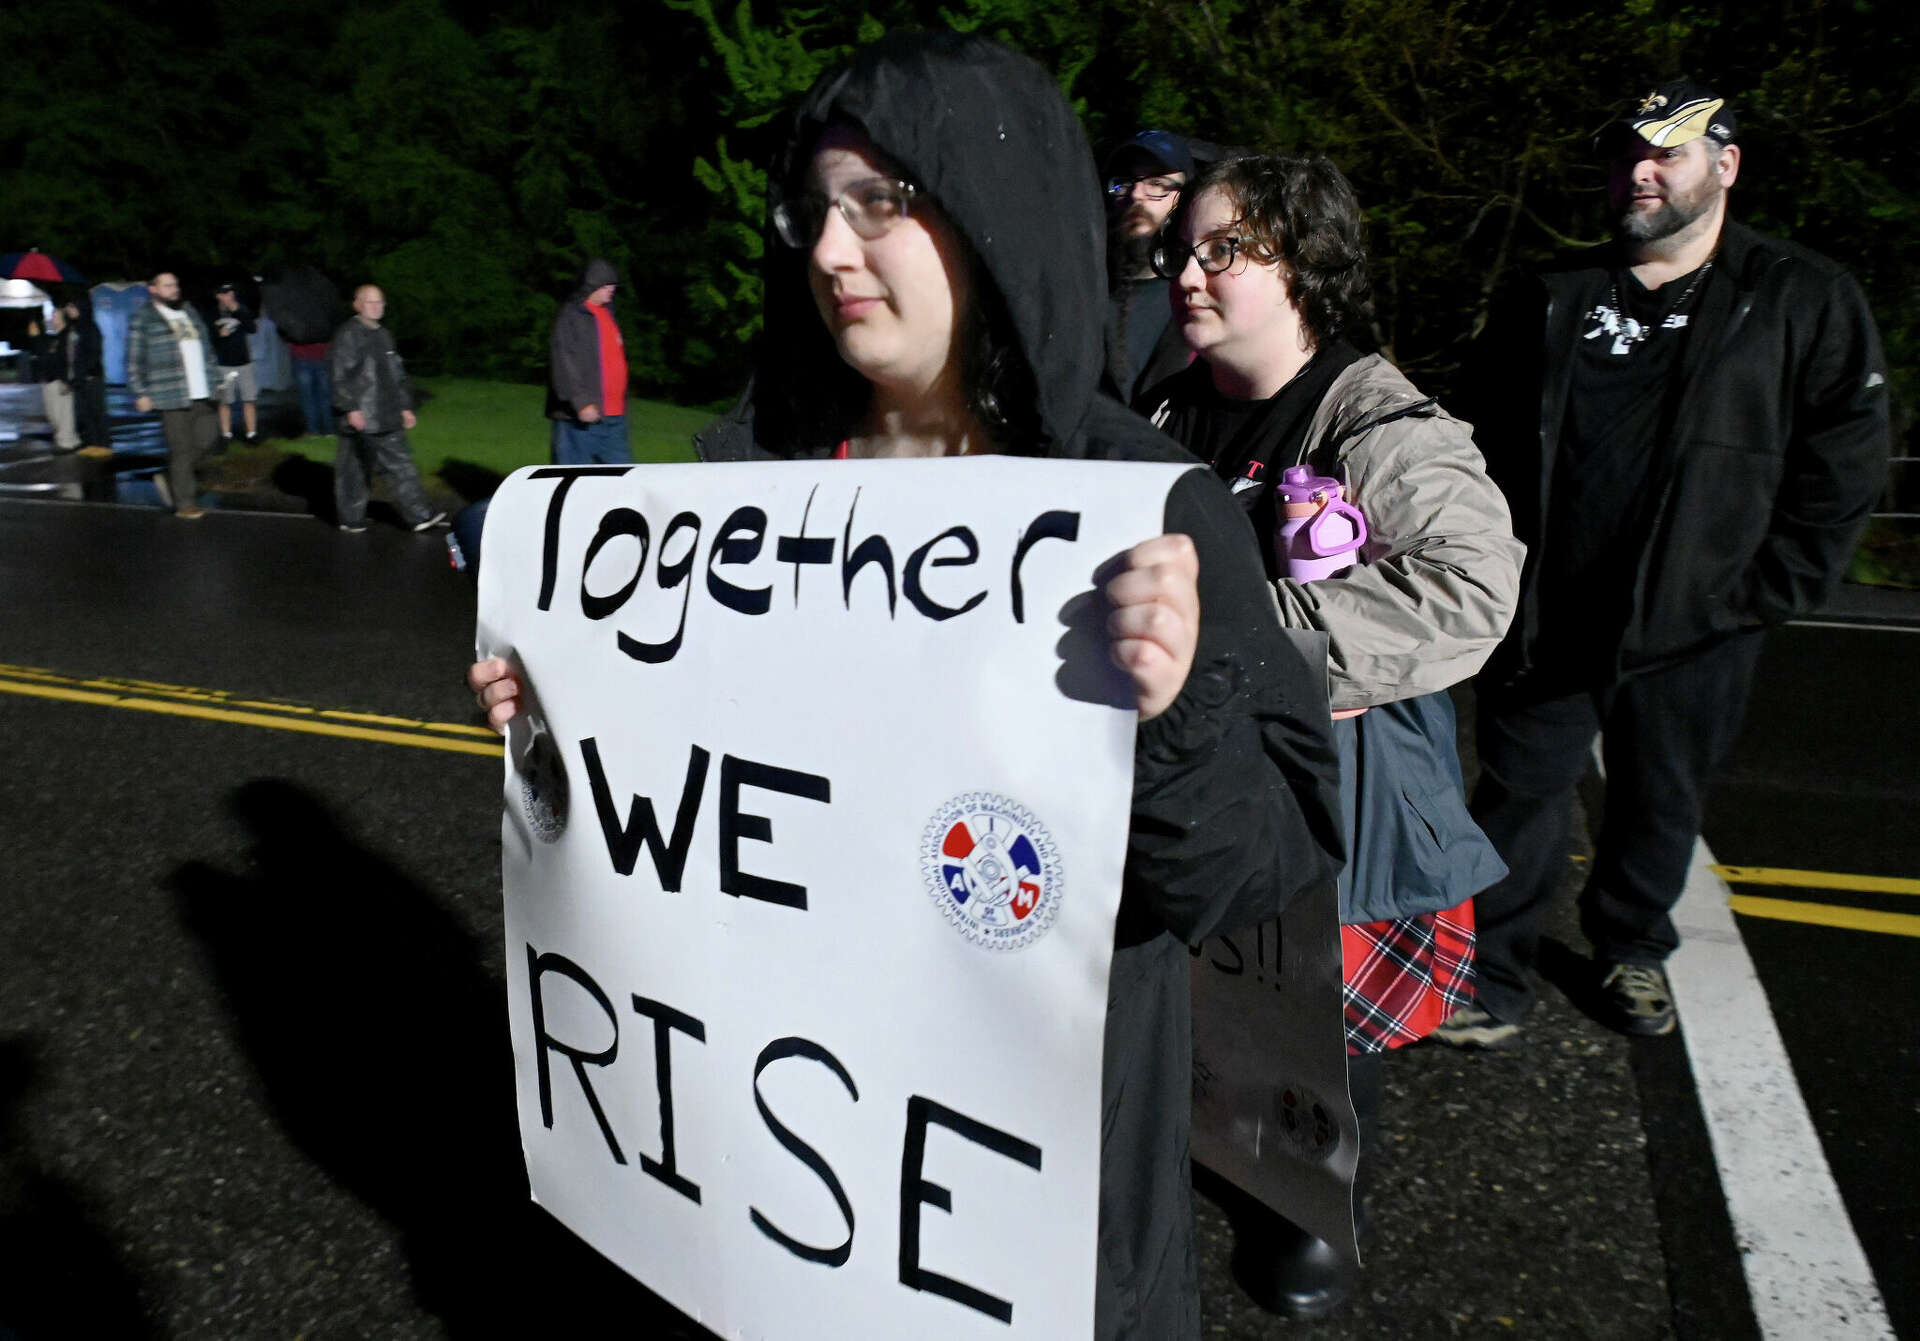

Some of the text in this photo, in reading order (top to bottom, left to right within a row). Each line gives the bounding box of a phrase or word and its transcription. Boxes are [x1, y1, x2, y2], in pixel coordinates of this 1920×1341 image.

[526, 467, 1081, 664] Together
[579, 735, 832, 911] WE
[525, 941, 1043, 1326] RISE
